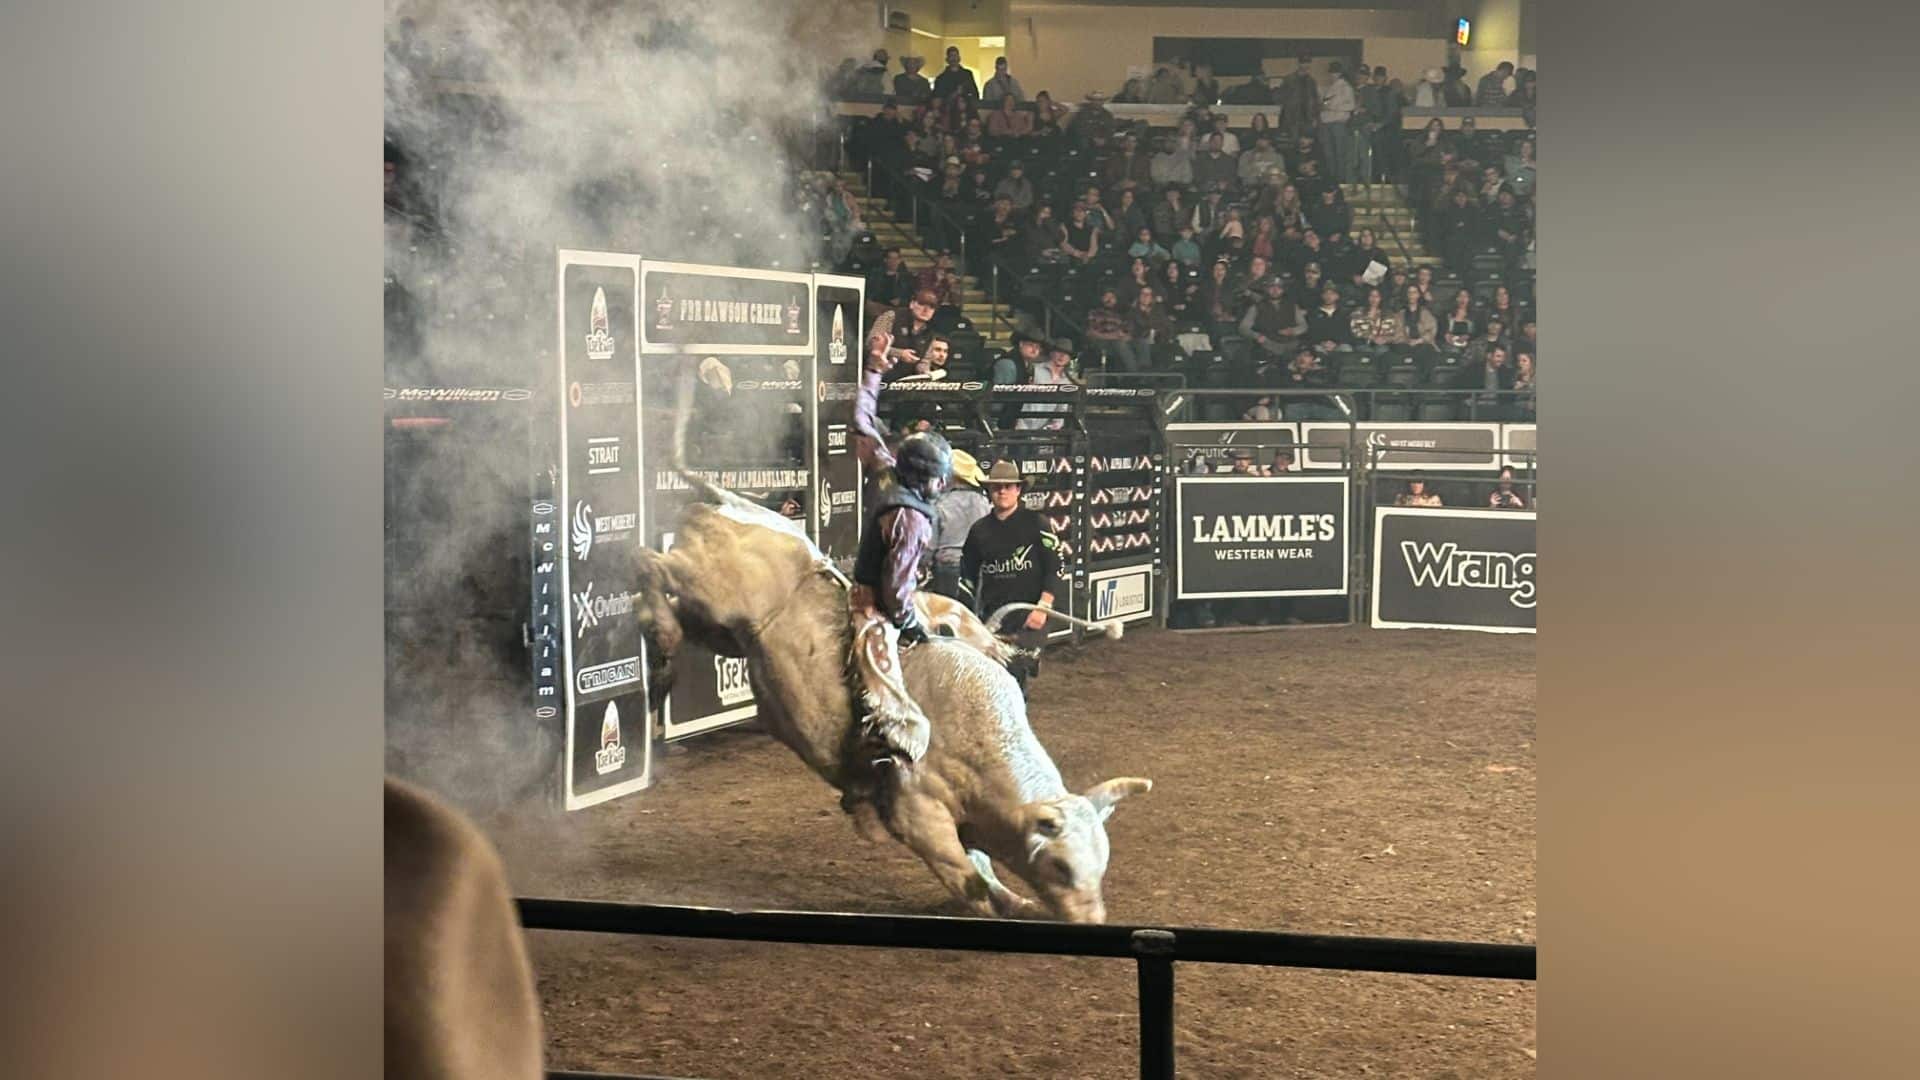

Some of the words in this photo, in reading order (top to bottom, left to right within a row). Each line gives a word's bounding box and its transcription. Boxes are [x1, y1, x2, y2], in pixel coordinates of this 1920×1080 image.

[704, 300, 749, 323] DAWSON
[750, 303, 782, 325] CREEK
[828, 431, 847, 446] STRAIT
[588, 445, 620, 465] STRAIT
[1192, 513, 1336, 544] LAMMLE'S
[1215, 549, 1274, 560] WESTERN
[1278, 547, 1313, 560] WEAR
